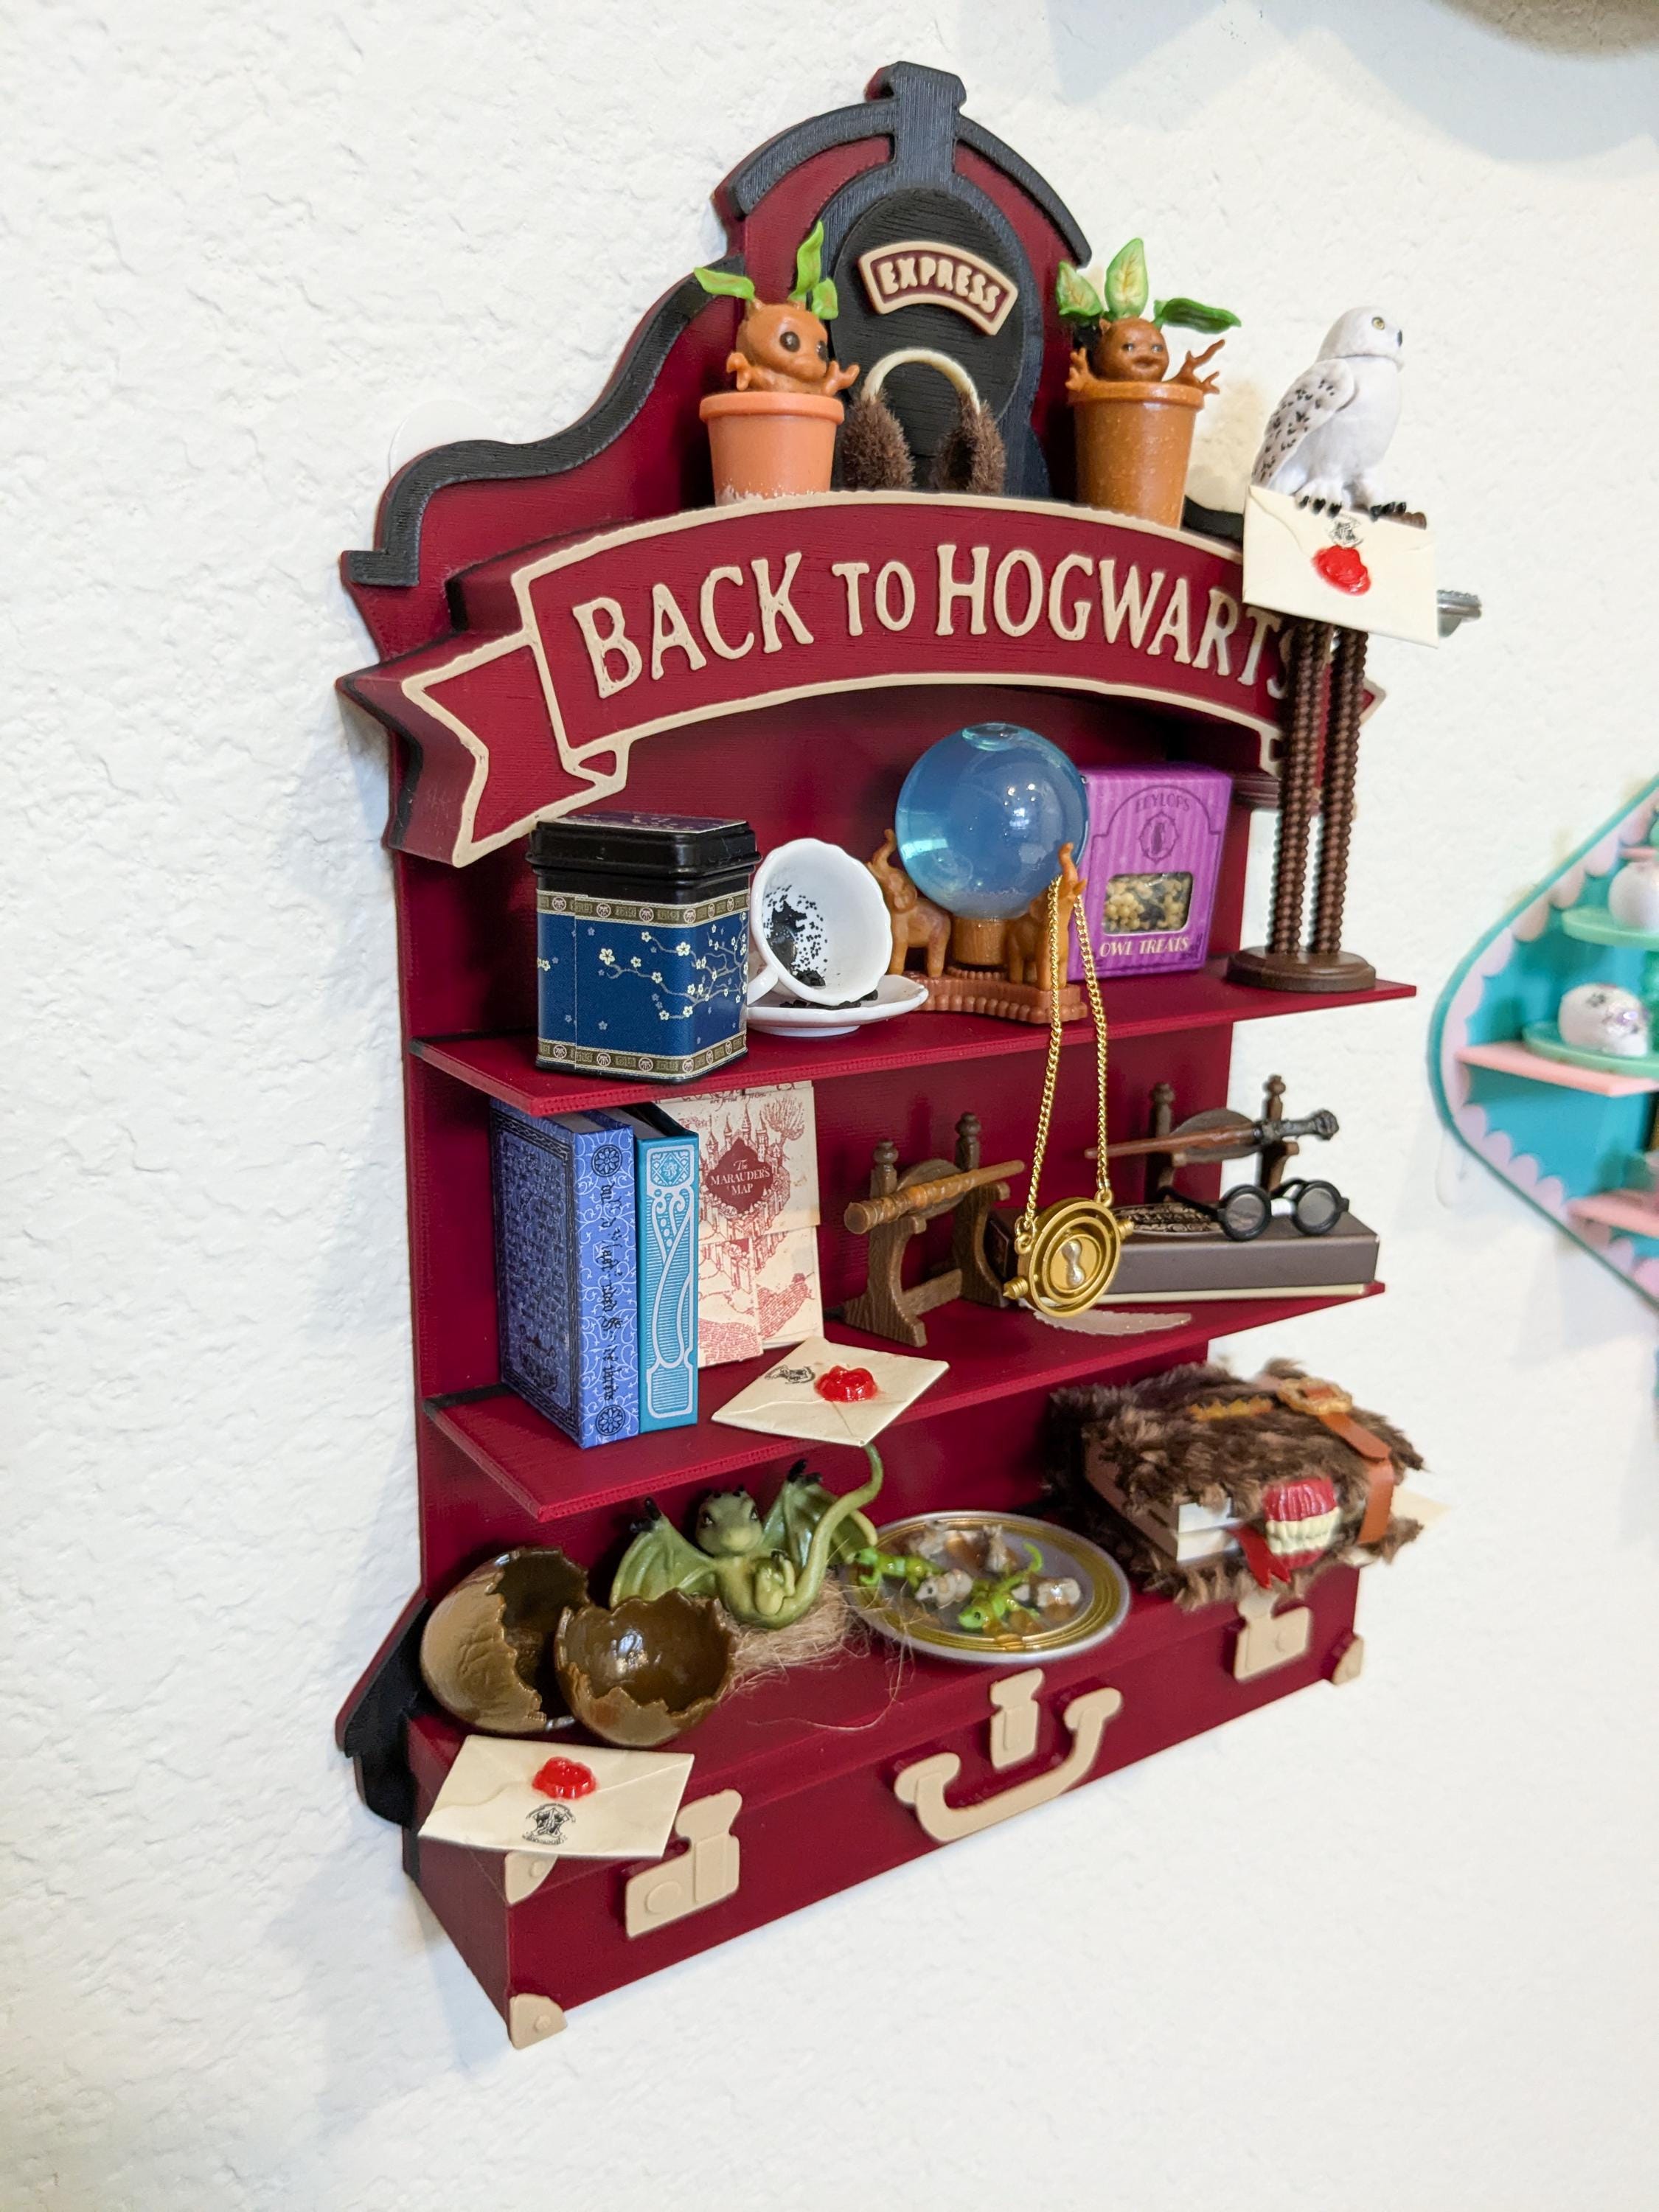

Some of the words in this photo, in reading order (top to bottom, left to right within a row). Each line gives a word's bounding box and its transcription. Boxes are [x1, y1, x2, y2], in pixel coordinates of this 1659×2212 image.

[879, 257, 1001, 313] EXPRESS
[572, 551, 815, 699] BACK
[831, 560, 916, 637] TO
[1099, 940, 1133, 957] OWL
[1138, 936, 1191, 955] TREATS
[733, 1159, 748, 1171] The
[710, 1166, 771, 1186] MARAUDER'S
[728, 1183, 754, 1196] MAP
